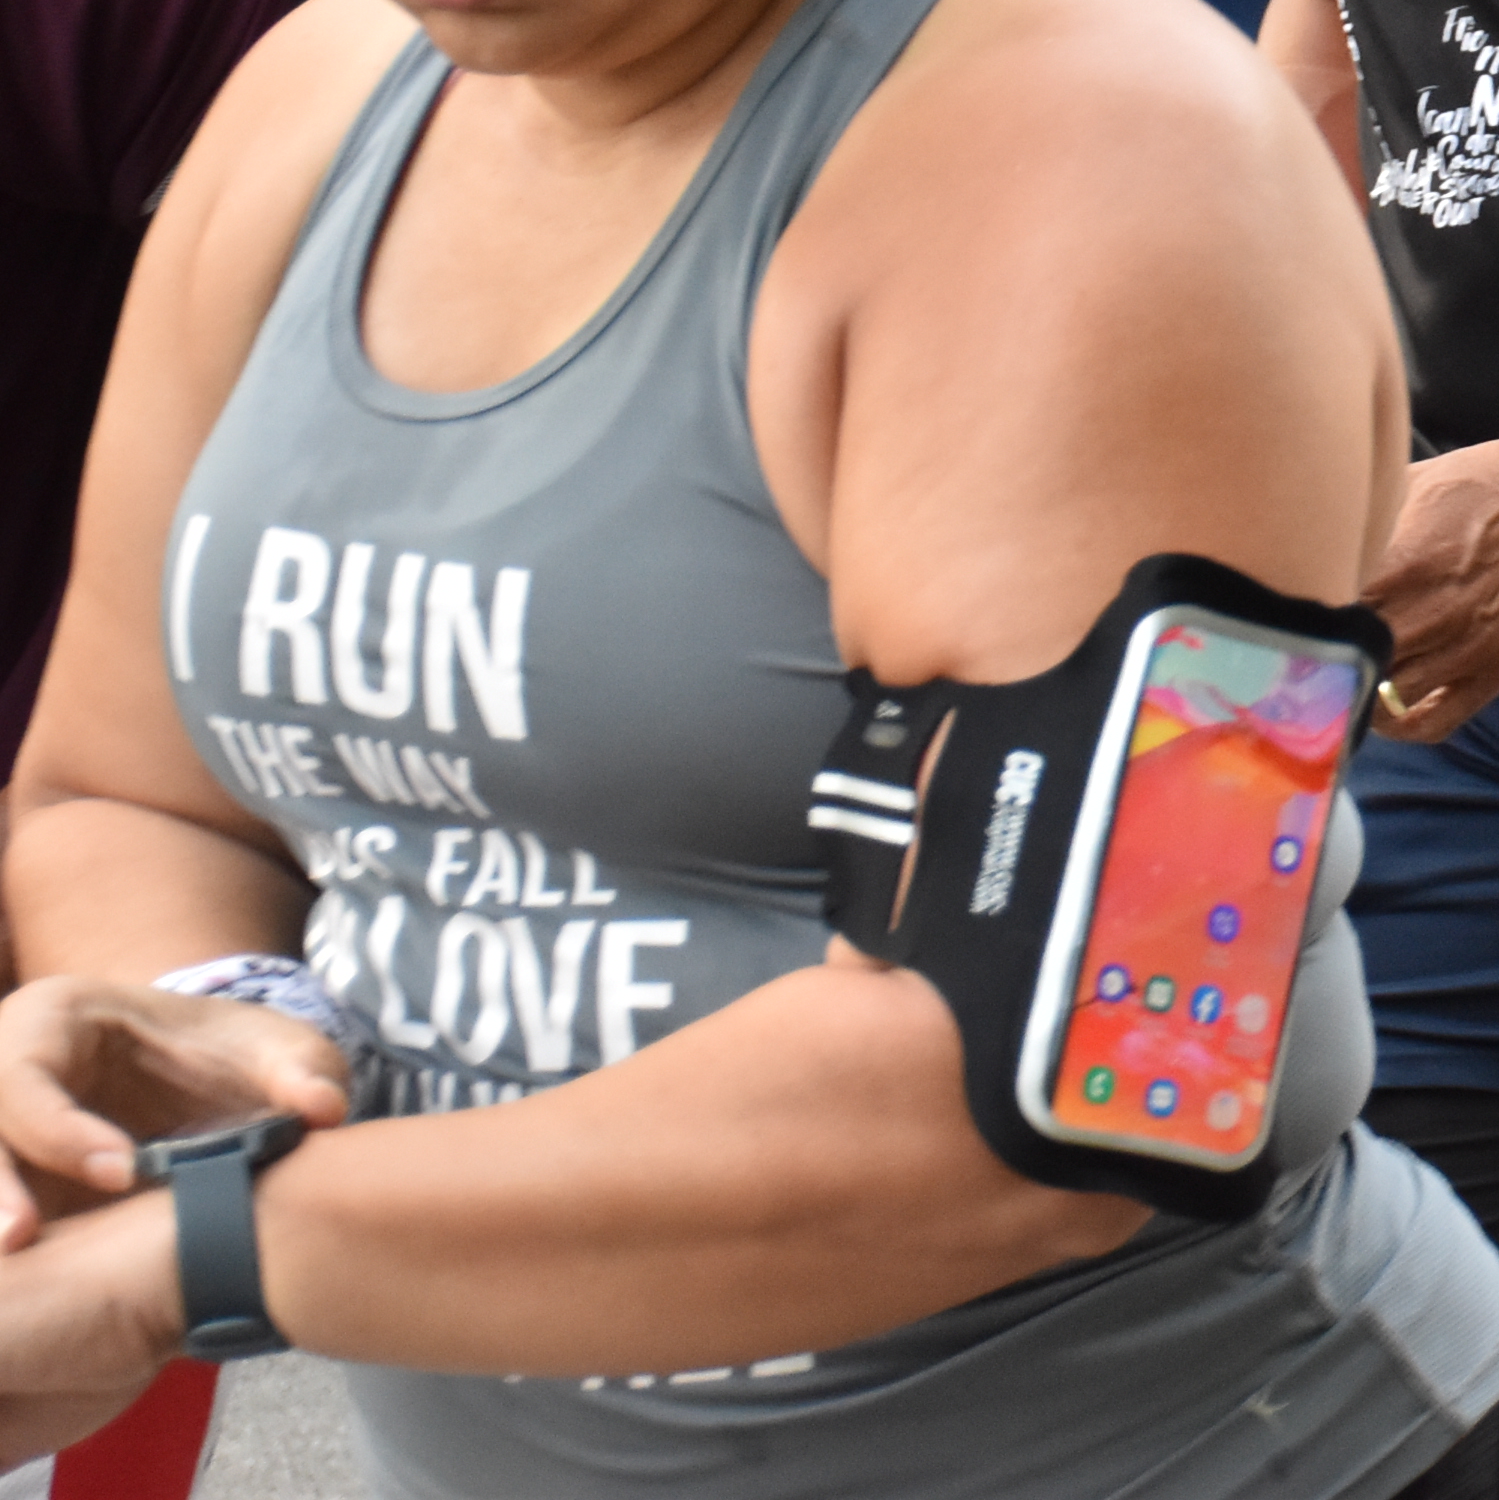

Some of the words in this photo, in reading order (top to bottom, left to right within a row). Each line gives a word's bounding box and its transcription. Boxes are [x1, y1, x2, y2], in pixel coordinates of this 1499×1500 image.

[169, 514, 211, 683] I
[238, 525, 531, 742] RUN
[205, 714, 344, 799] THE
[333, 732, 492, 819] WAY
[425, 826, 619, 909] FALL
[366, 894, 692, 1073] LOVE
